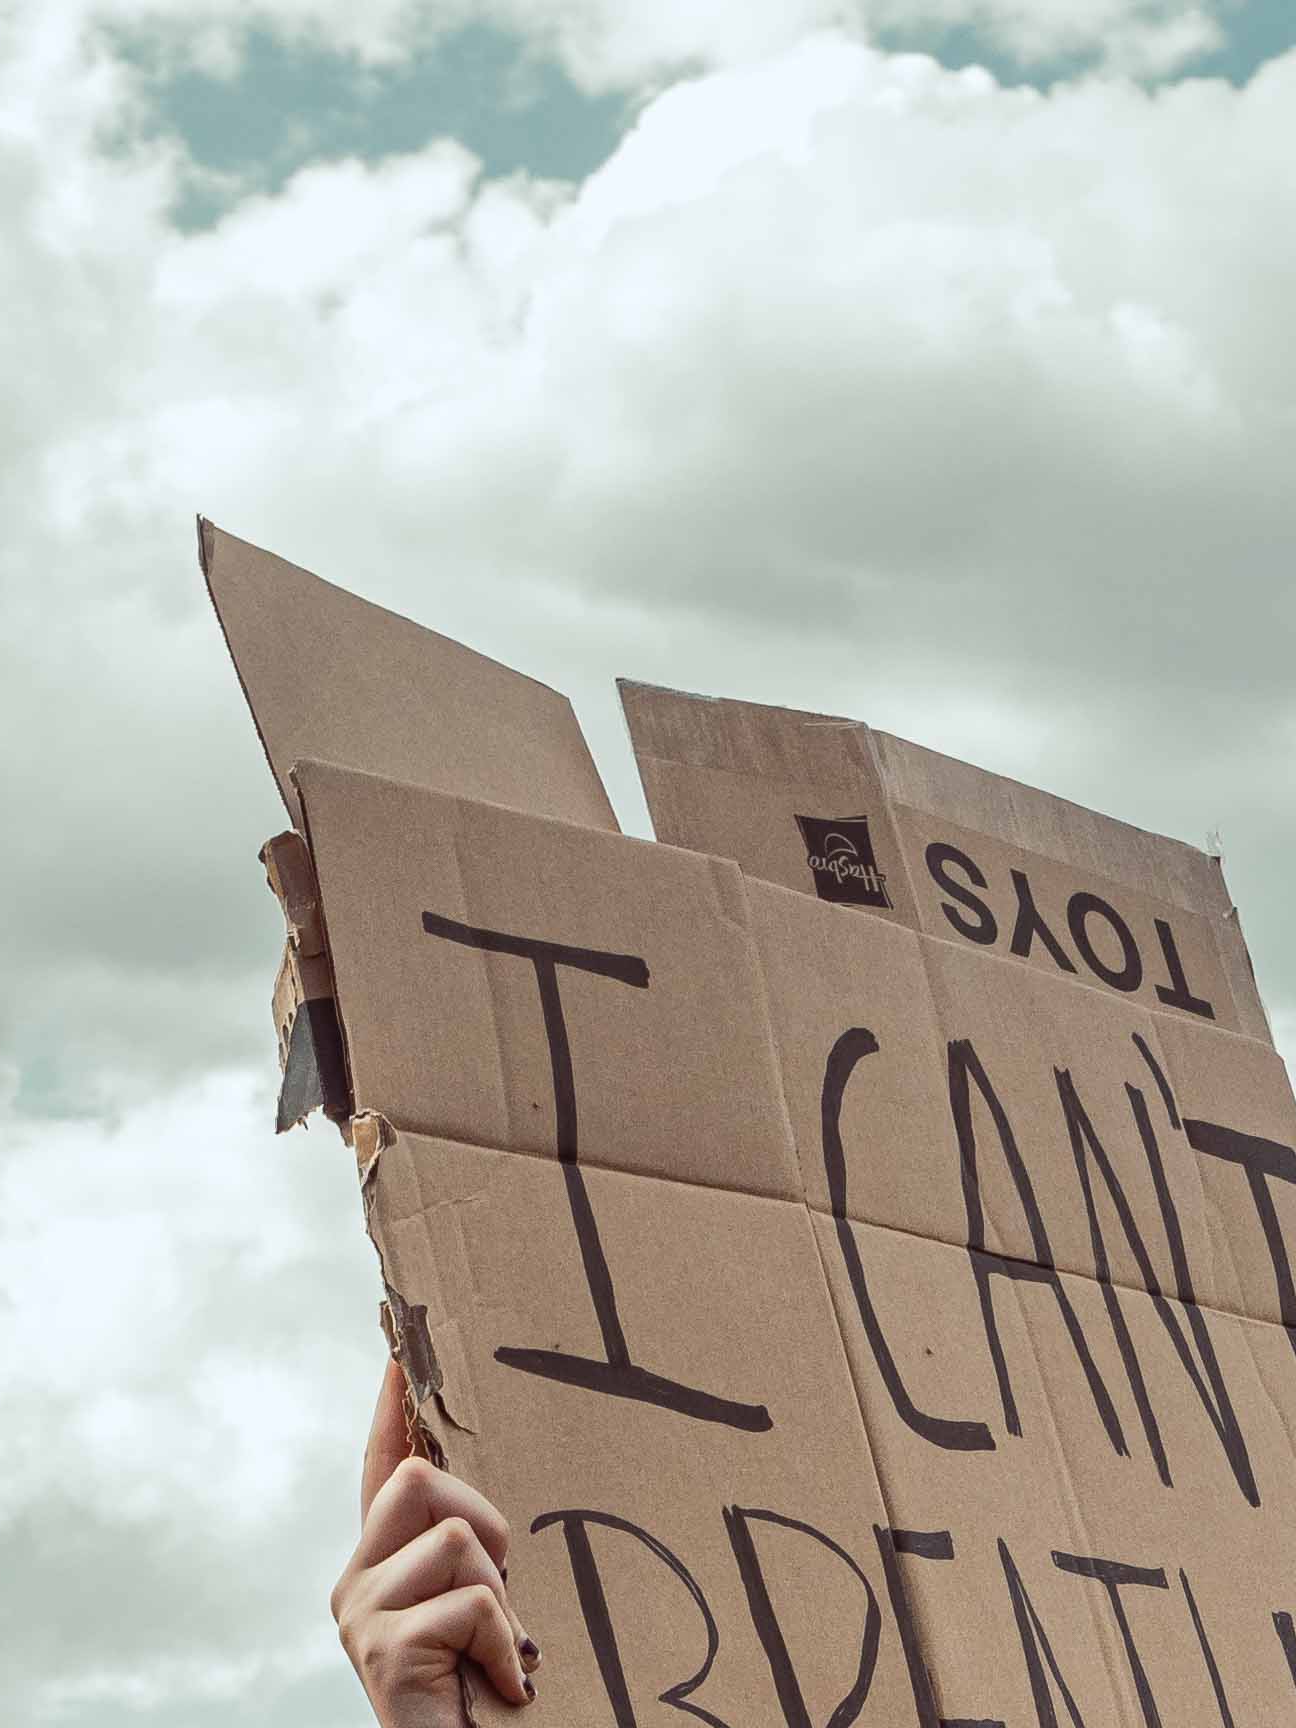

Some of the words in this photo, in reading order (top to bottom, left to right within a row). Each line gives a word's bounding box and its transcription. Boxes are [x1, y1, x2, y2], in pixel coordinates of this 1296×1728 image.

[809, 852, 886, 893] Hasbro
[924, 842, 1215, 1020] TOYS
[421, 911, 773, 1433] I
